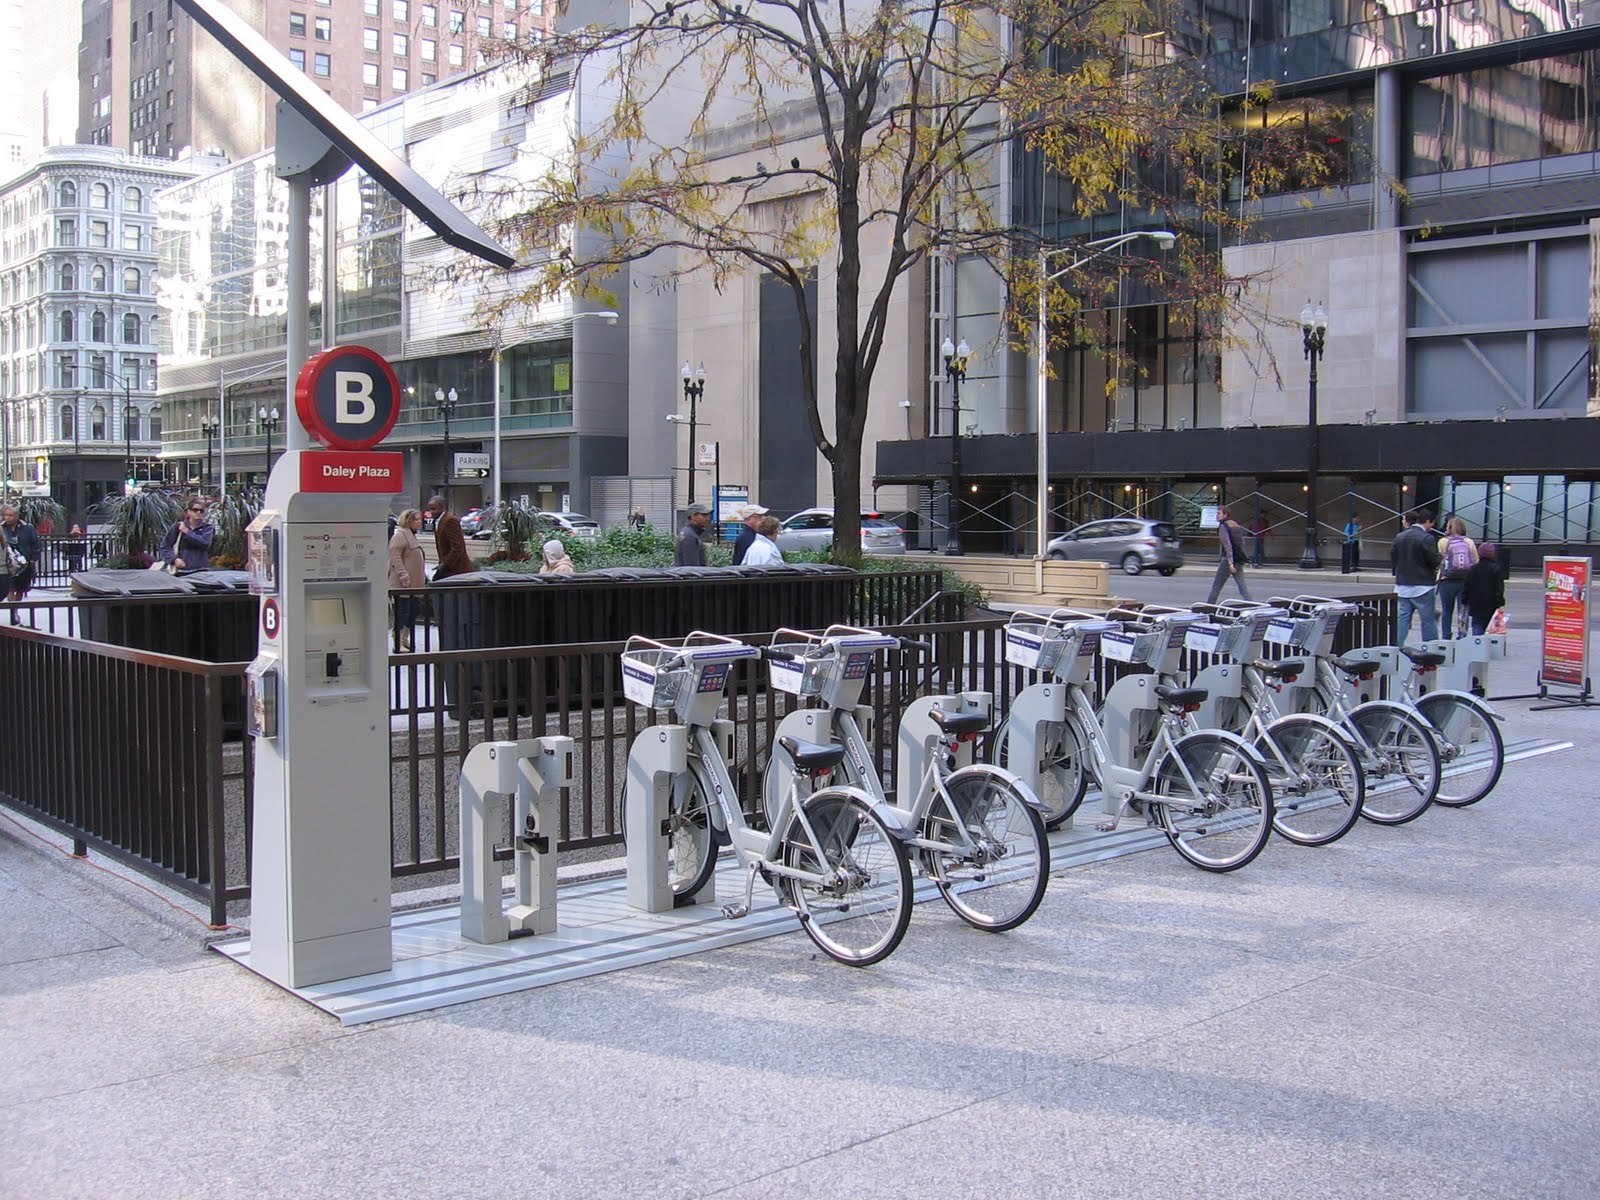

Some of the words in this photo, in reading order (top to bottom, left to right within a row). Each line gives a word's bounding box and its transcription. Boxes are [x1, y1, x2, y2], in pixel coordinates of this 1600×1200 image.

[335, 371, 376, 424] B
[459, 457, 489, 465] PARKING
[322, 465, 356, 479] Daley
[359, 465, 391, 478] Plaza
[266, 607, 276, 629] B
